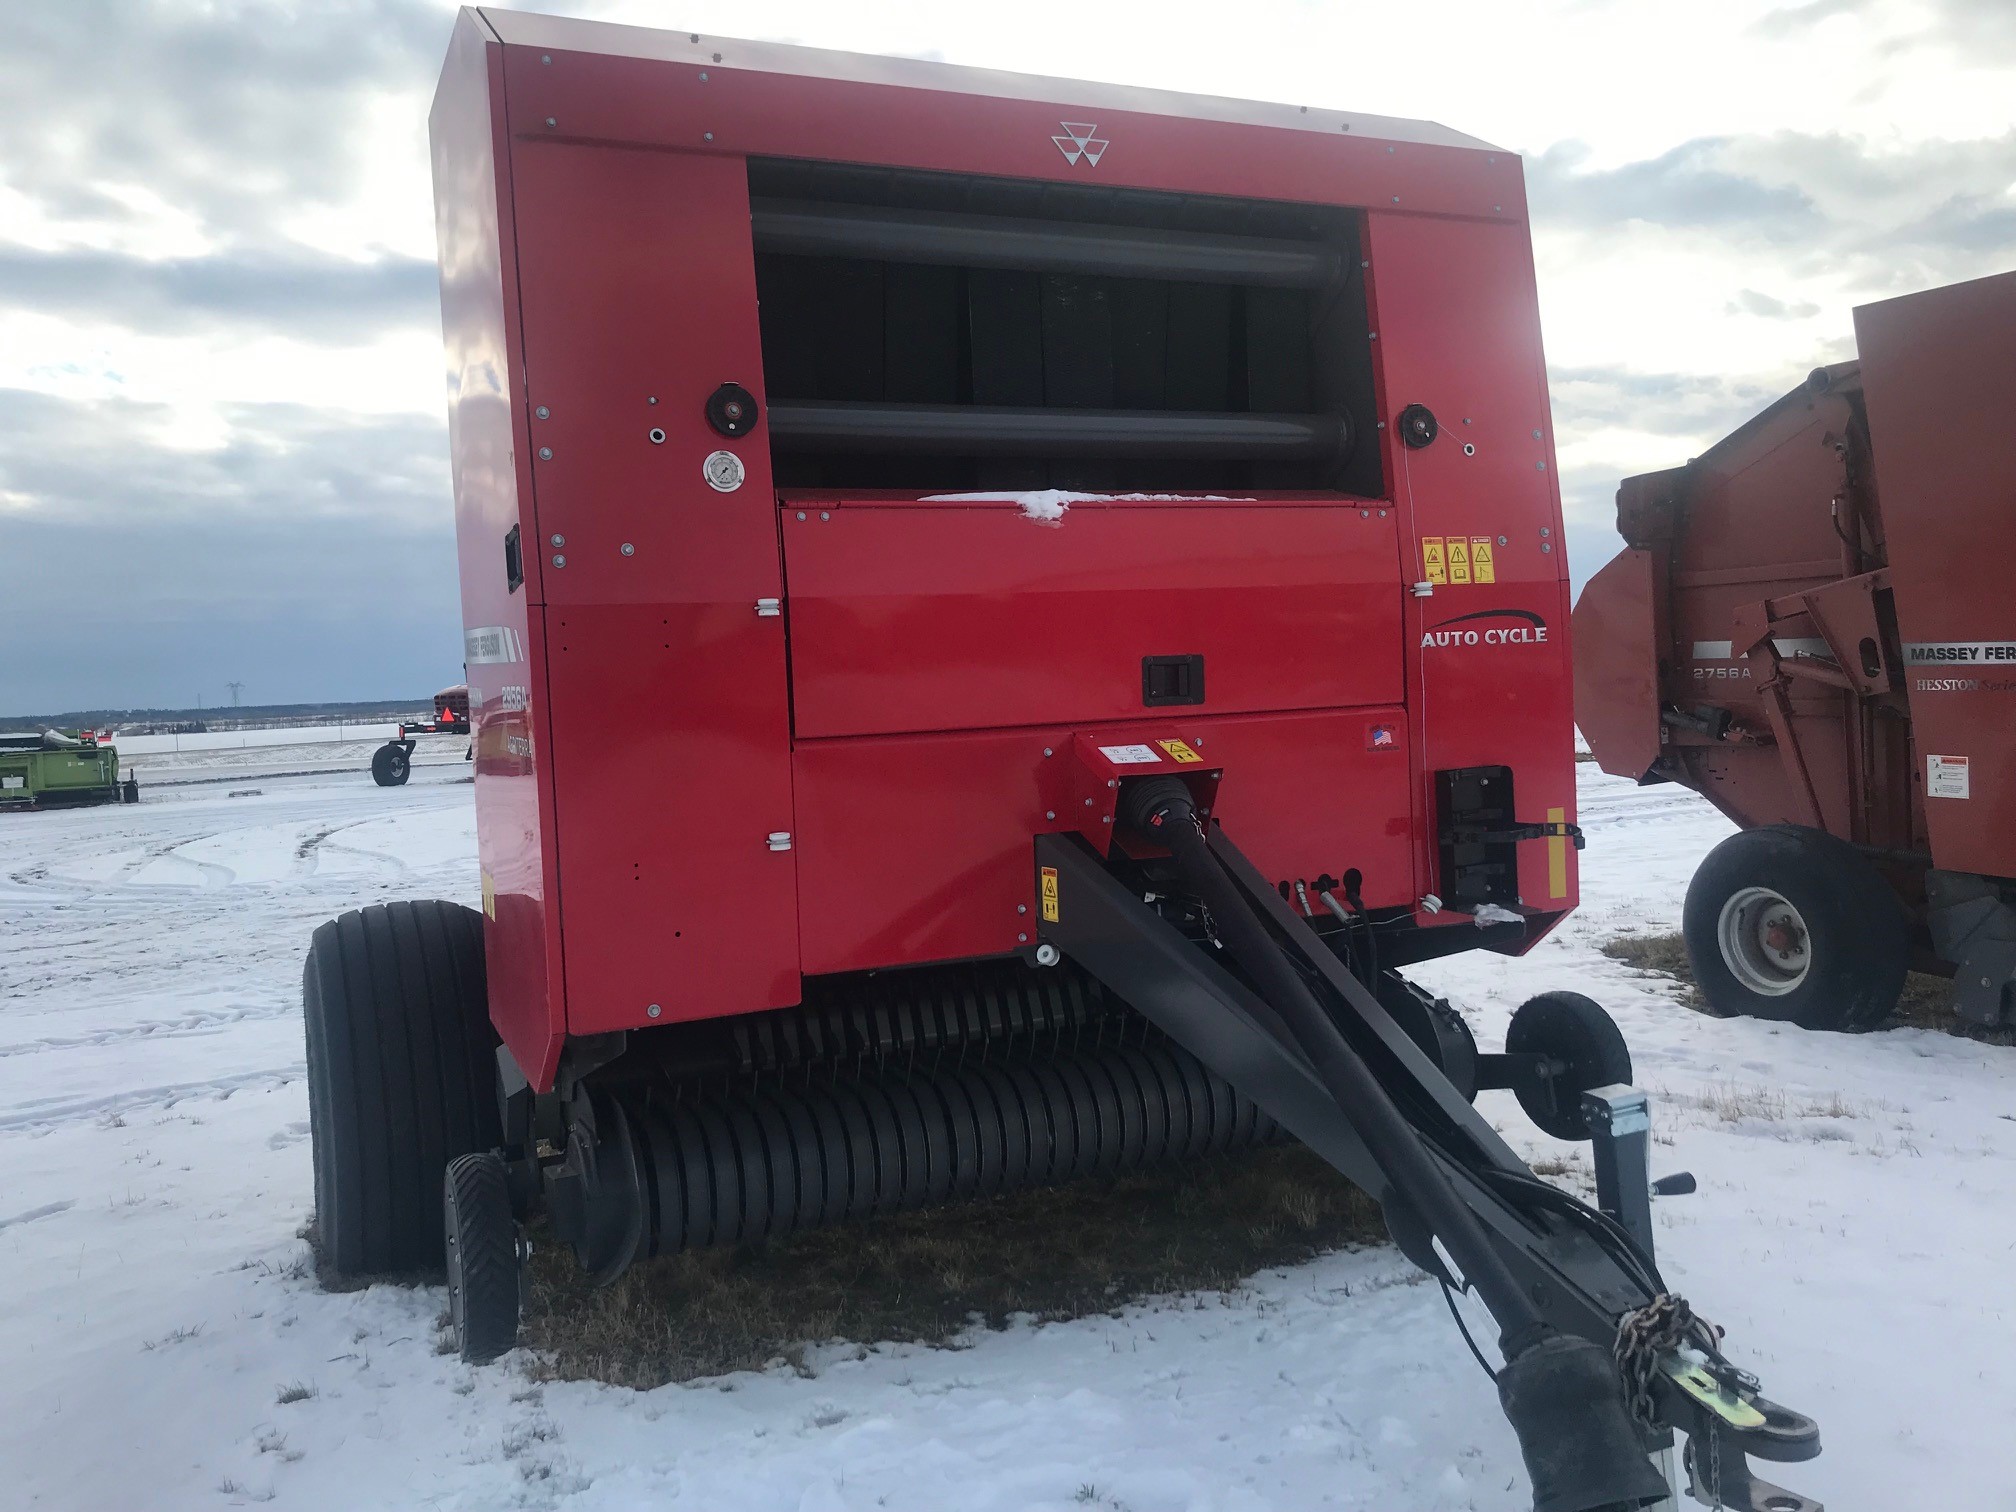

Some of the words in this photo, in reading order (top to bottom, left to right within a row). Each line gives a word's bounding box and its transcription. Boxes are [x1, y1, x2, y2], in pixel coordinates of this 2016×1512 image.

[1420, 631, 1479, 648] AUTO
[1484, 627, 1548, 645] CYCLE
[1911, 647, 1979, 660] MASSEY
[1693, 667, 1752, 679] 2756A
[1917, 679, 1979, 691] HESSTON
[502, 686, 528, 710] 2956A
